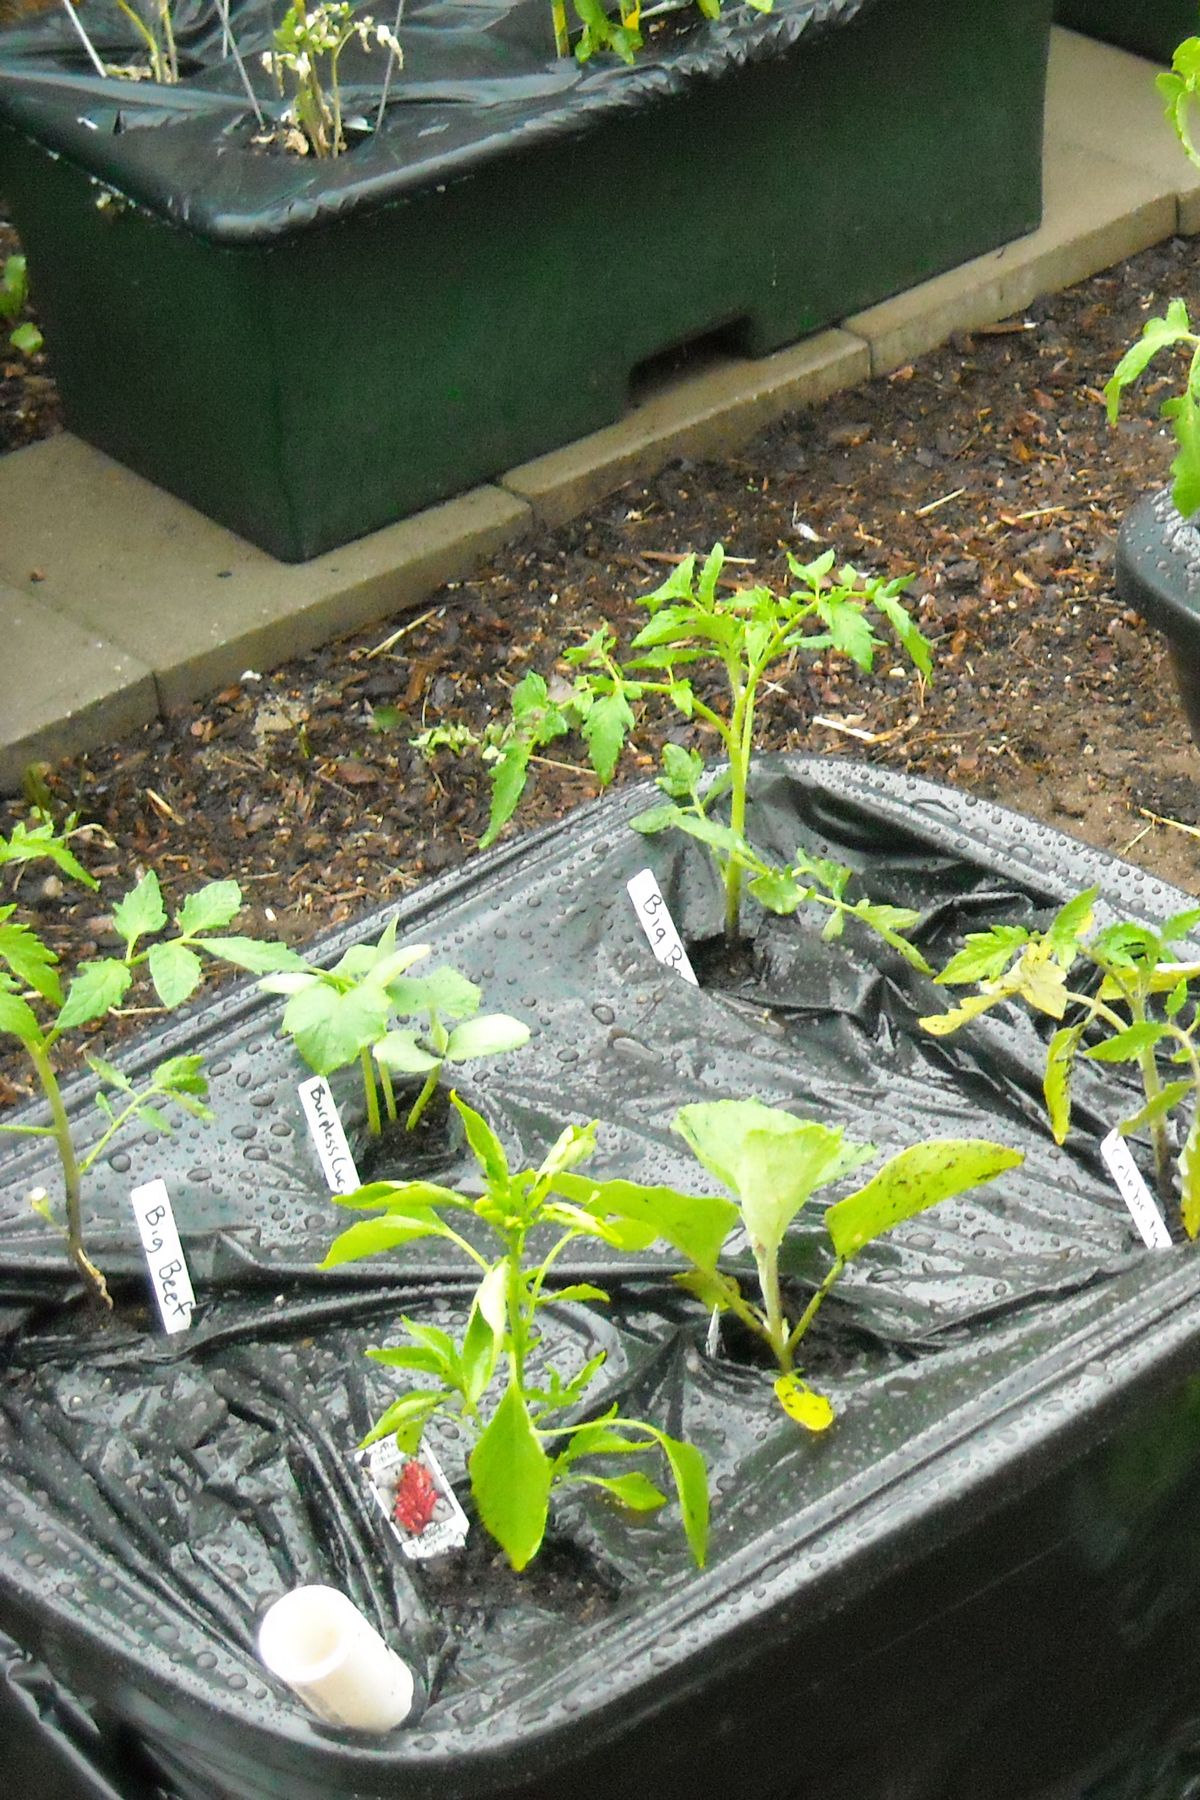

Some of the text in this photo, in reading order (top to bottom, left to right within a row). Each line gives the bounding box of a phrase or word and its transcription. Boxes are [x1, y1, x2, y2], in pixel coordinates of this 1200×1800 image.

[643, 893, 666, 946] Big
[310, 1083, 339, 1157] Burpless
[145, 1205, 193, 1316] Big Beef
